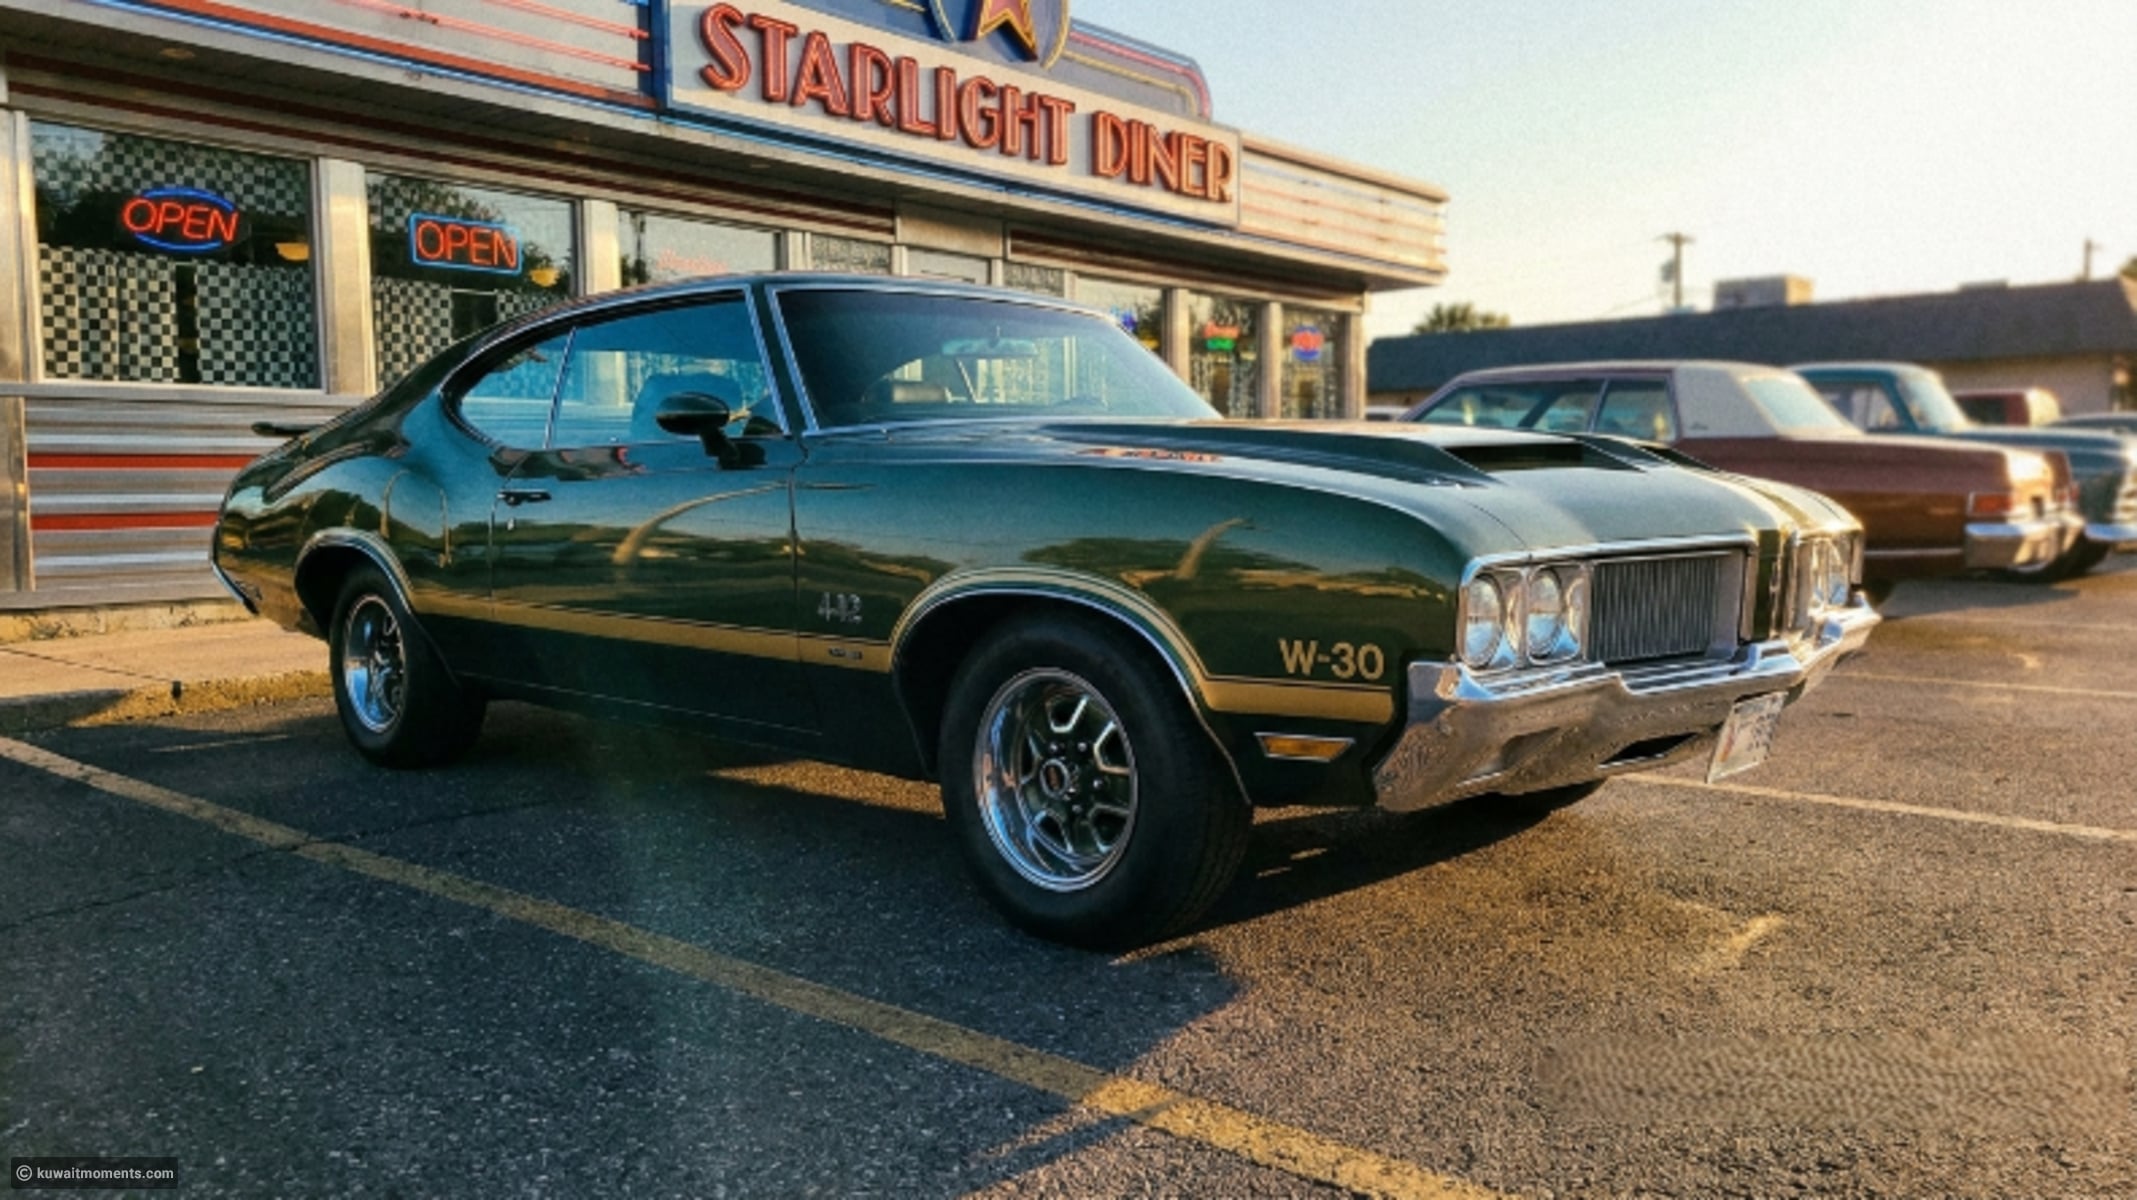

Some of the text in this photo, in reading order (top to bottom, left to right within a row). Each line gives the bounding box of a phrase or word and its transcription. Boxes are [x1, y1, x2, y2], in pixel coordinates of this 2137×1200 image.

[699, 2, 1233, 202] STARLIGHT DINER
[122, 197, 239, 242] OPEN
[416, 220, 517, 268] OPEN
[1279, 637, 1385, 680] W-30
